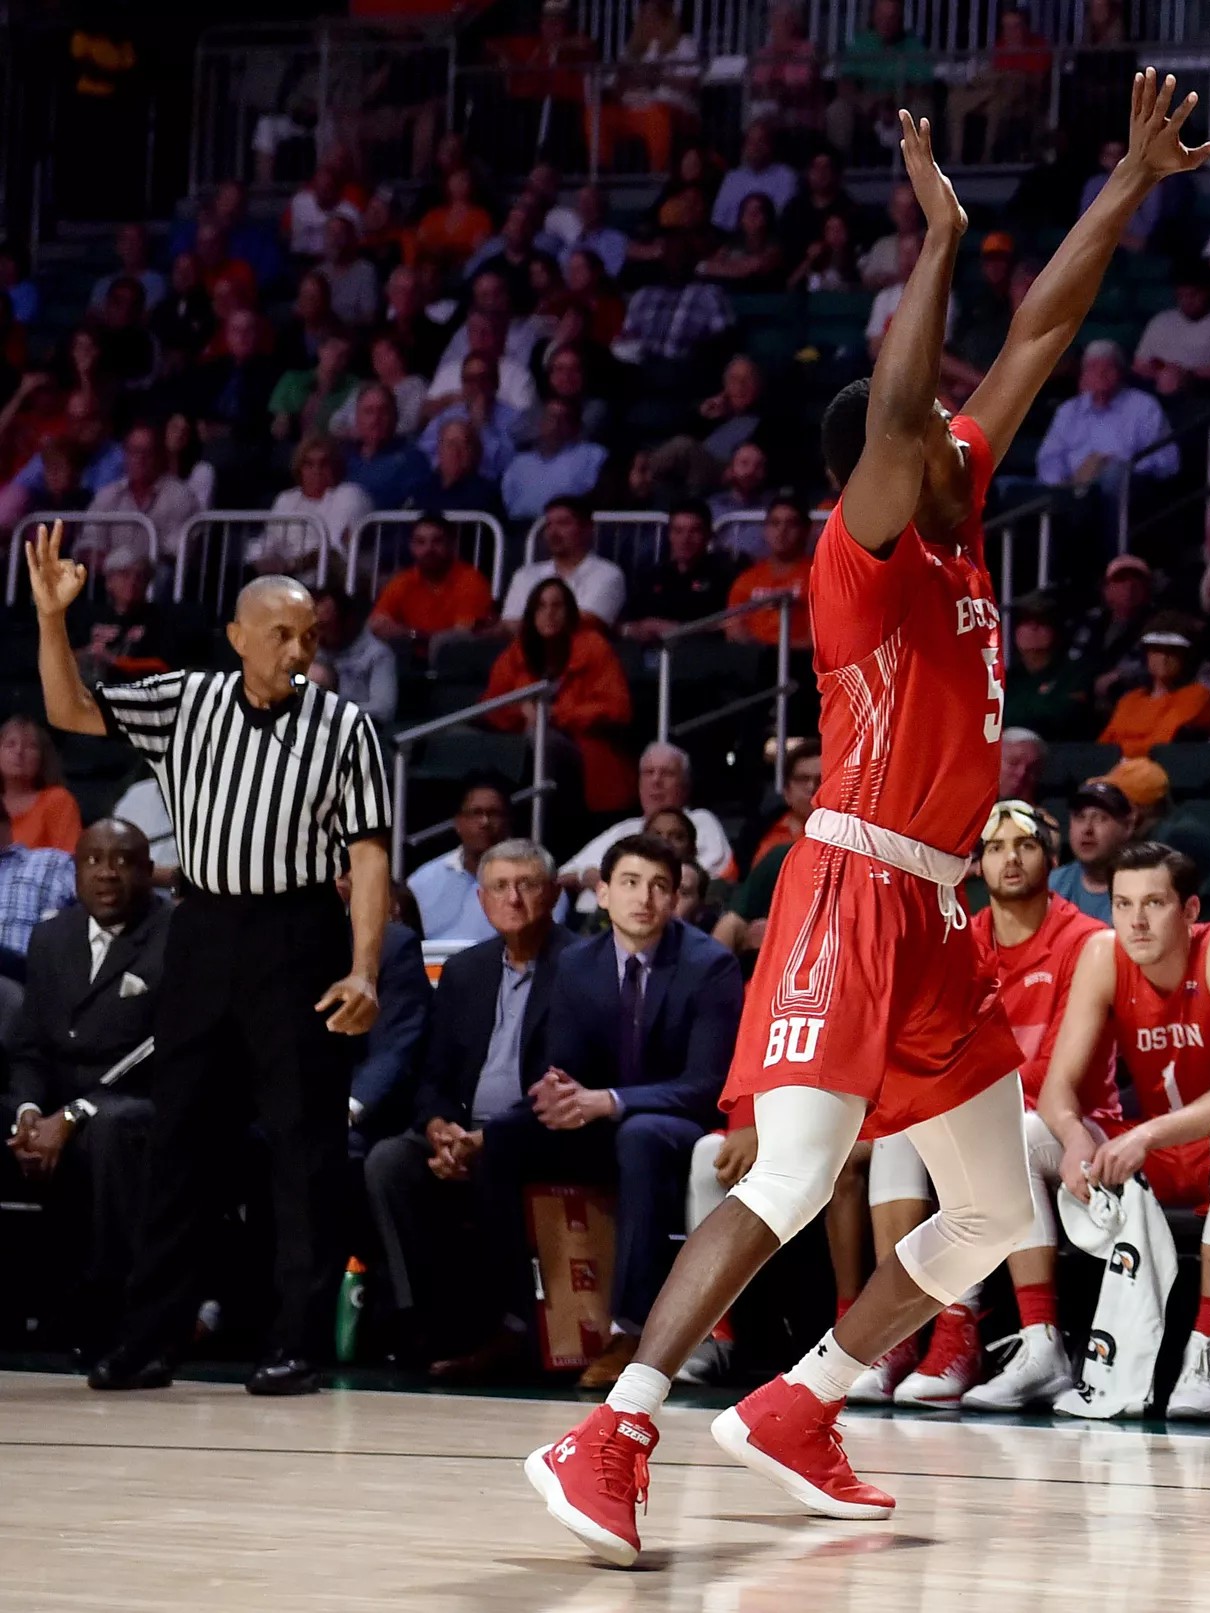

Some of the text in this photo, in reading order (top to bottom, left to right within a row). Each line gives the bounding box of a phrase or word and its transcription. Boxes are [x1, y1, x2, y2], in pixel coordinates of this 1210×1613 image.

[981, 648, 1004, 744] 5
[763, 1017, 825, 1069] BU
[1136, 1023, 1205, 1052] OSTON
